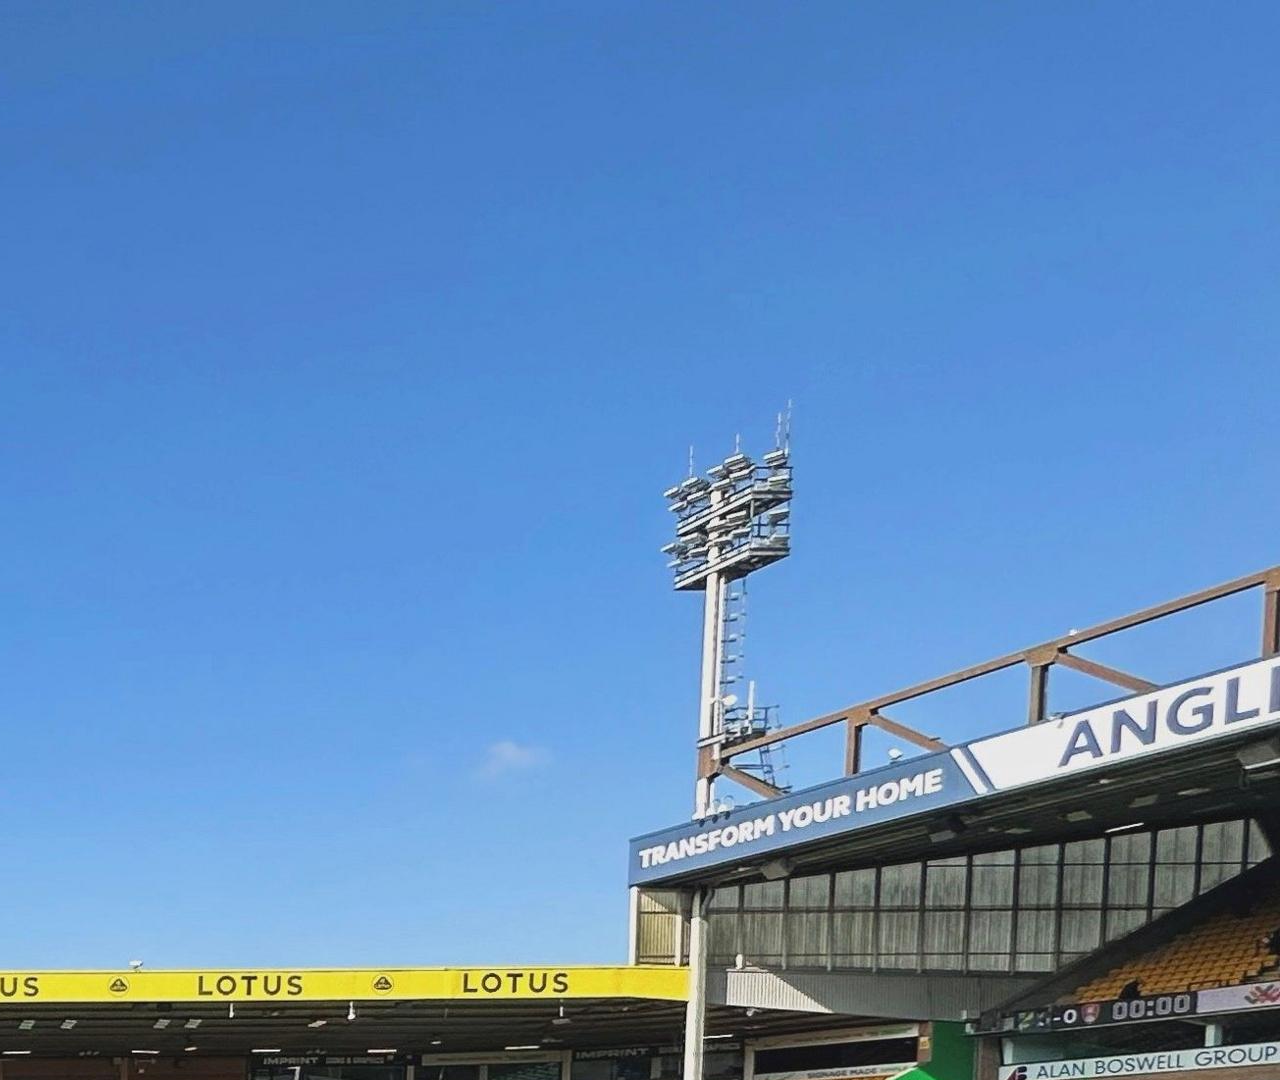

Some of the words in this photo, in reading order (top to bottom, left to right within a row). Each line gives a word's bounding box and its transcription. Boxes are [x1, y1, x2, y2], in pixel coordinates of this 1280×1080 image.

[638, 814, 775, 869] TRANSFORM
[777, 795, 851, 832] YOUR
[856, 768, 943, 812] HOME
[197, 975, 302, 996] LOTUS
[462, 973, 569, 993] LOTUS
[1112, 995, 1190, 1021] 00:00
[850, 1067, 878, 1076] MADE
[1036, 1065, 1085, 1079] ALAN
[1095, 1054, 1184, 1075] BOSWELL
[1195, 1046, 1278, 1067] GROUP
